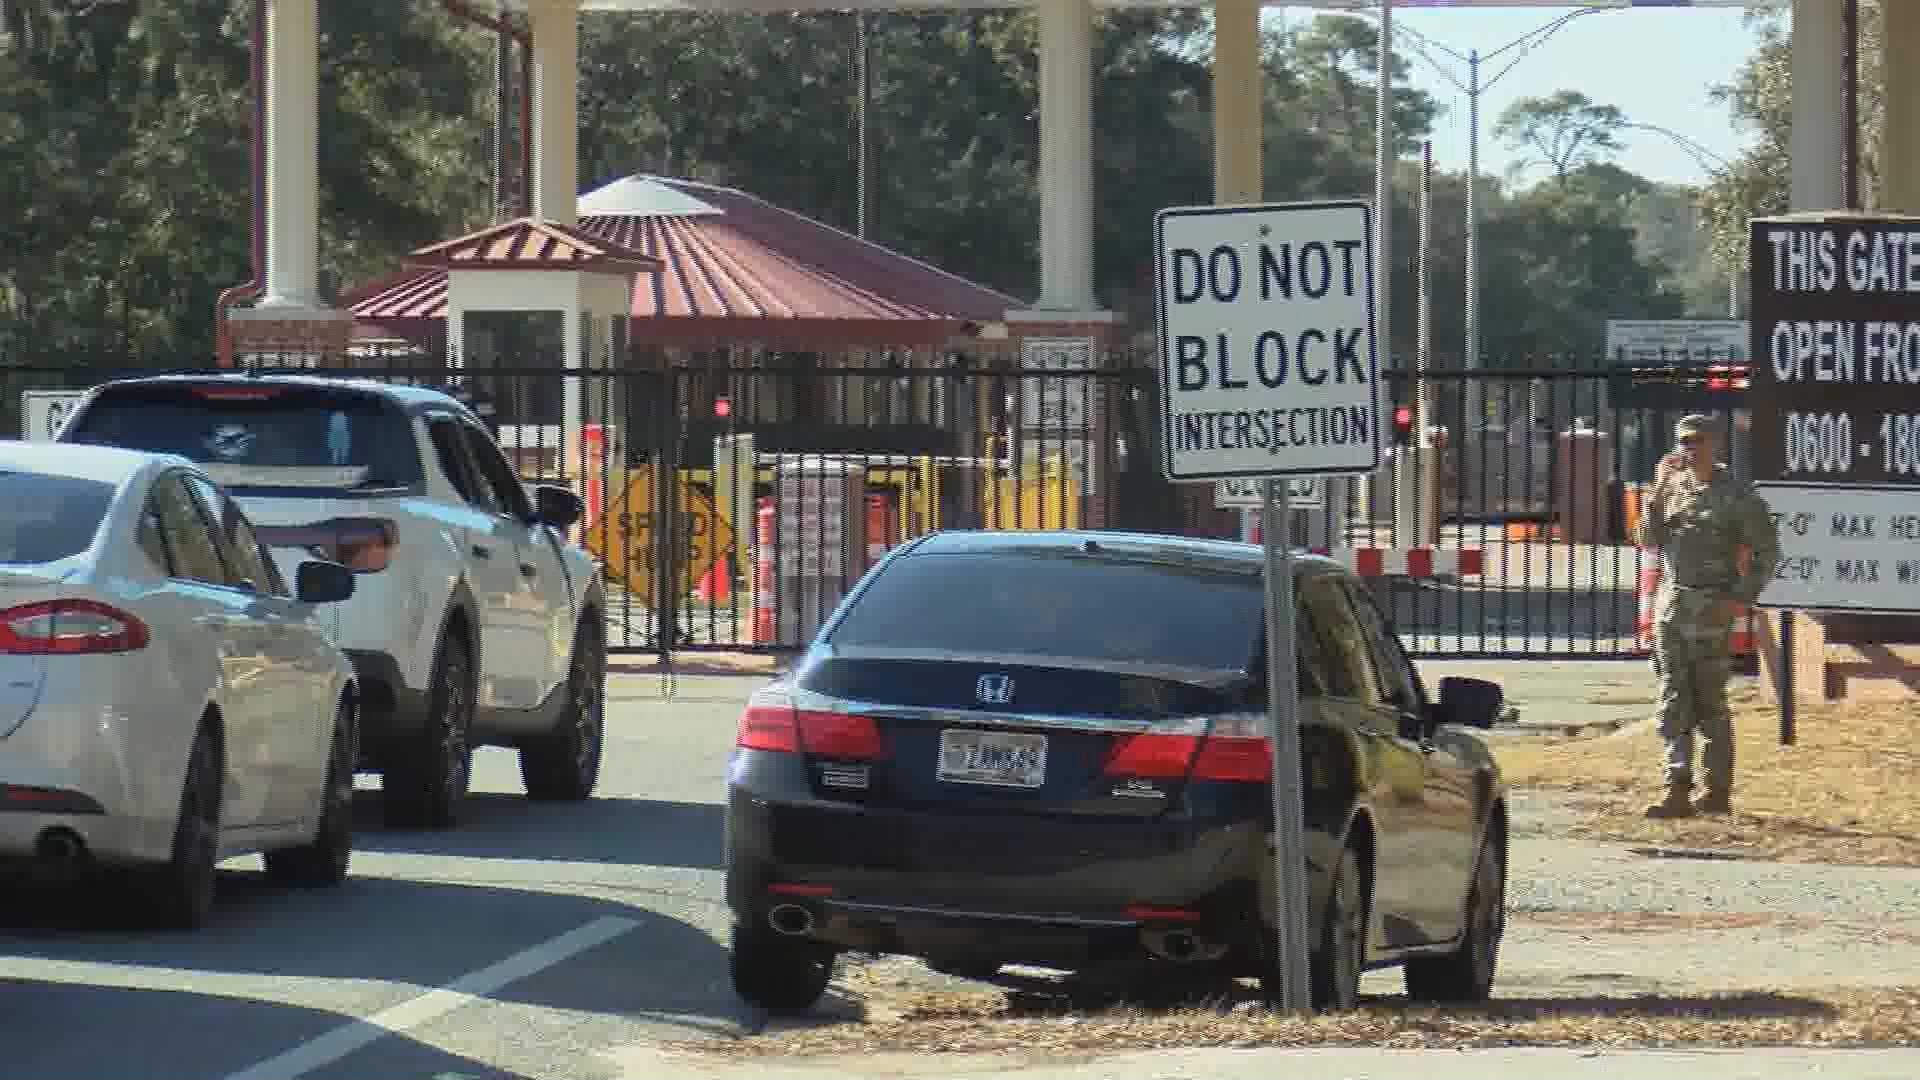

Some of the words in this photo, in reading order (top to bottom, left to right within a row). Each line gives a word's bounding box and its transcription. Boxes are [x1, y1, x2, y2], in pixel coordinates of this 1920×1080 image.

[1170, 244, 1242, 304] DO
[1259, 240, 1361, 302] NOT
[1767, 230, 1838, 292] THIS
[1846, 229, 1920, 293] GATE
[1175, 327, 1369, 393] BLOCK
[1771, 319, 1856, 383] OPEN
[1864, 320, 1920, 384] FRO
[1174, 406, 1370, 451] INTERSECTION
[1786, 411, 1852, 473] 0600
[618, 511, 707, 538] SPD
[1831, 512, 1876, 538] MAX
[1836, 559, 1881, 583] MAX
